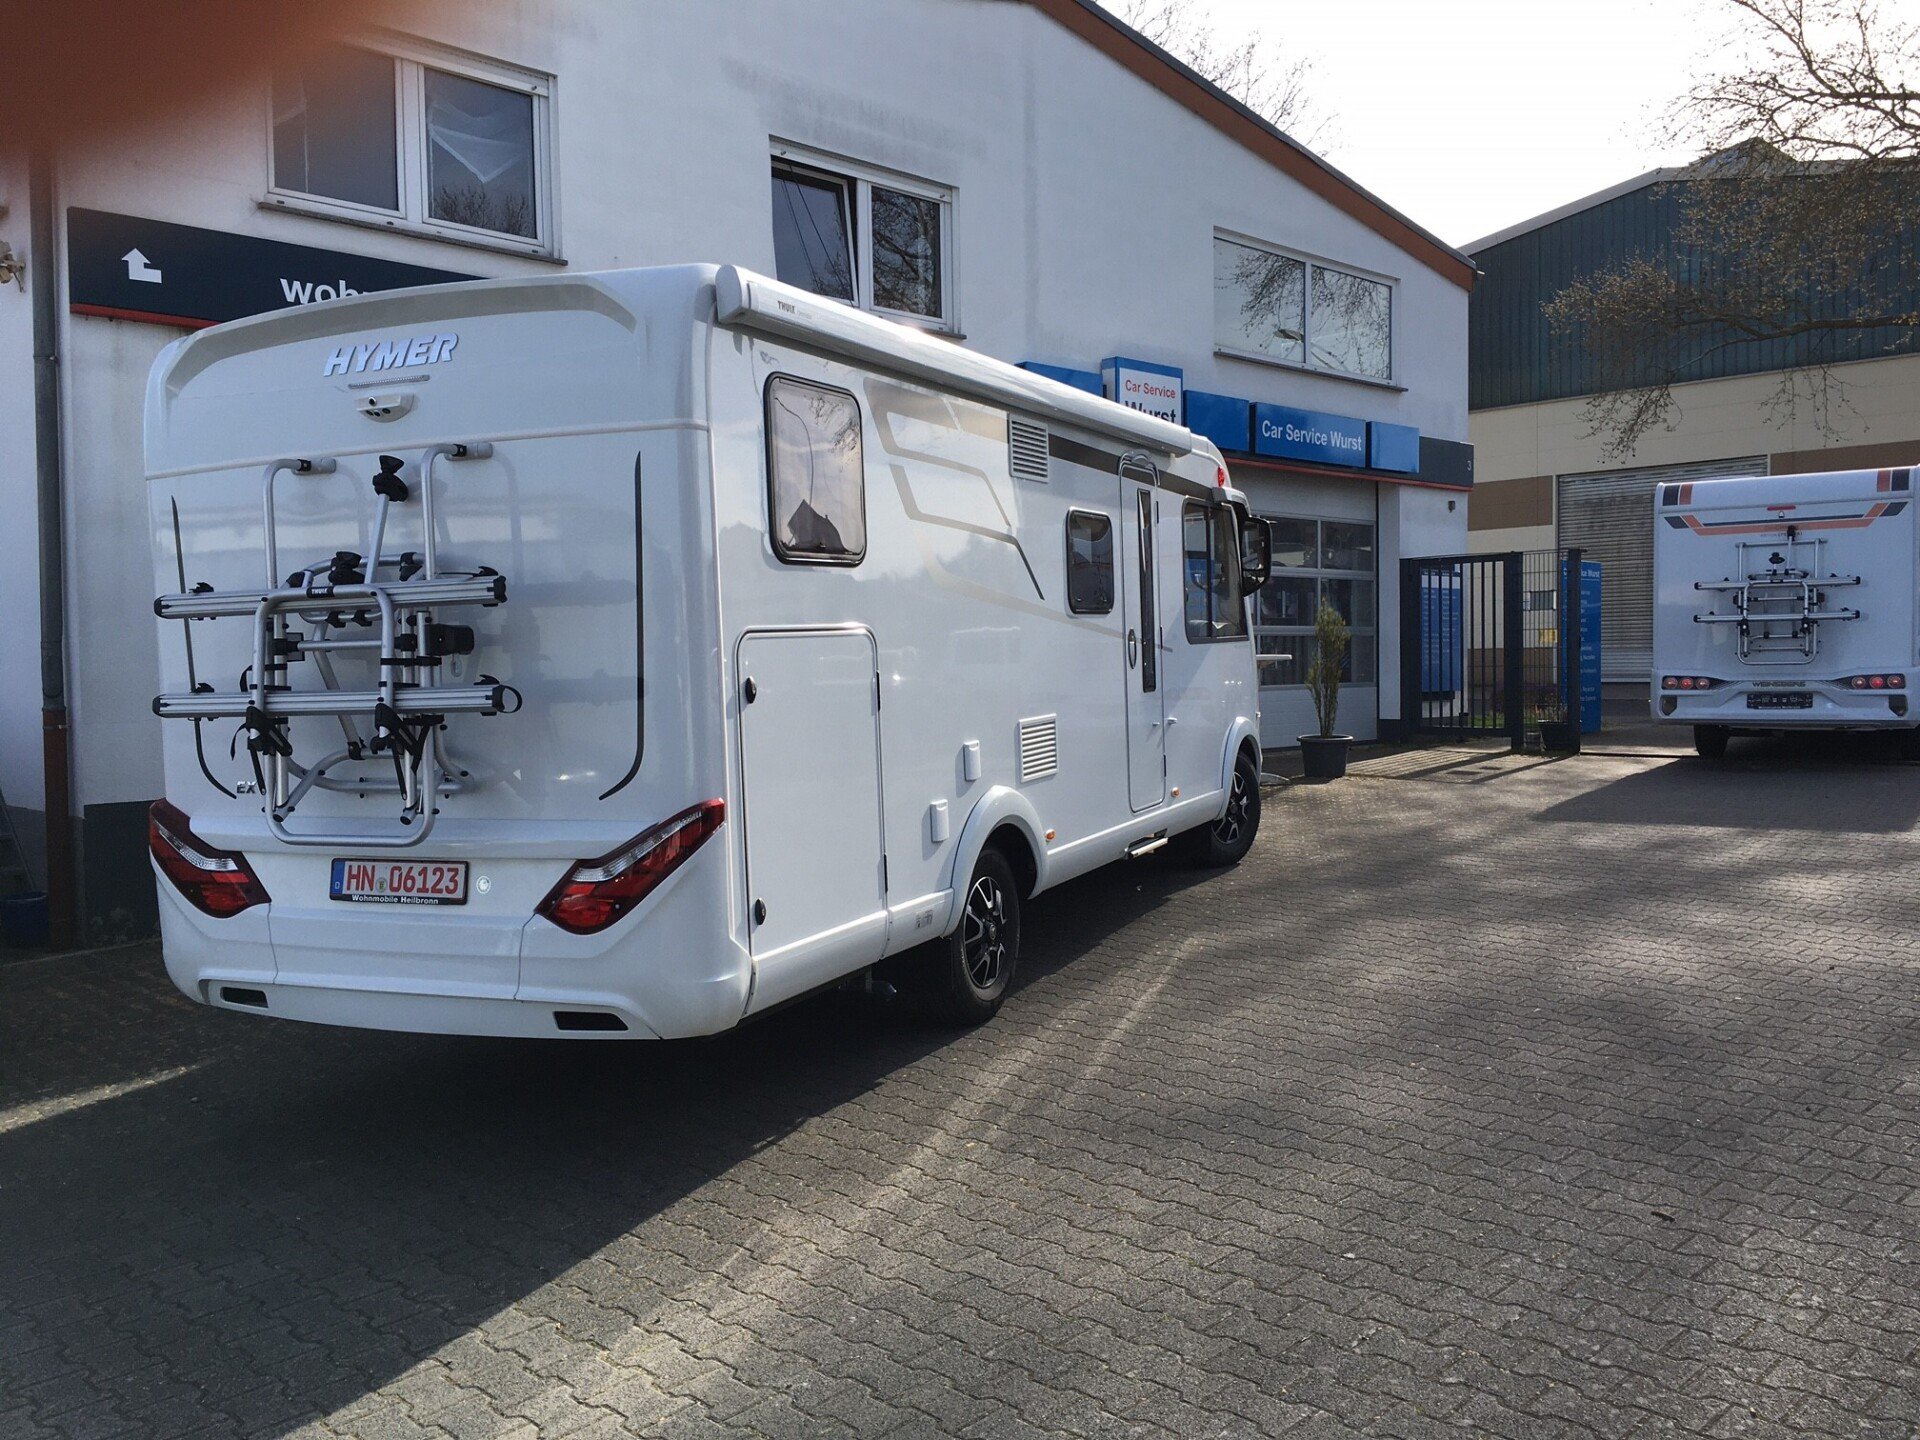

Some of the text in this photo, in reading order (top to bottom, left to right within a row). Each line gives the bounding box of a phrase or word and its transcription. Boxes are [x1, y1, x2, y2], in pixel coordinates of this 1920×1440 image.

[280, 278, 369, 305] woh
[323, 333, 459, 376] HYMER
[1125, 379, 1176, 399] Car Service
[1262, 419, 1362, 451] Car Service Wurst
[236, 781, 256, 794] EX
[346, 864, 375, 892] HN
[389, 866, 459, 895] 06123
[351, 893, 439, 905] Wohnmobile Heilbronn
